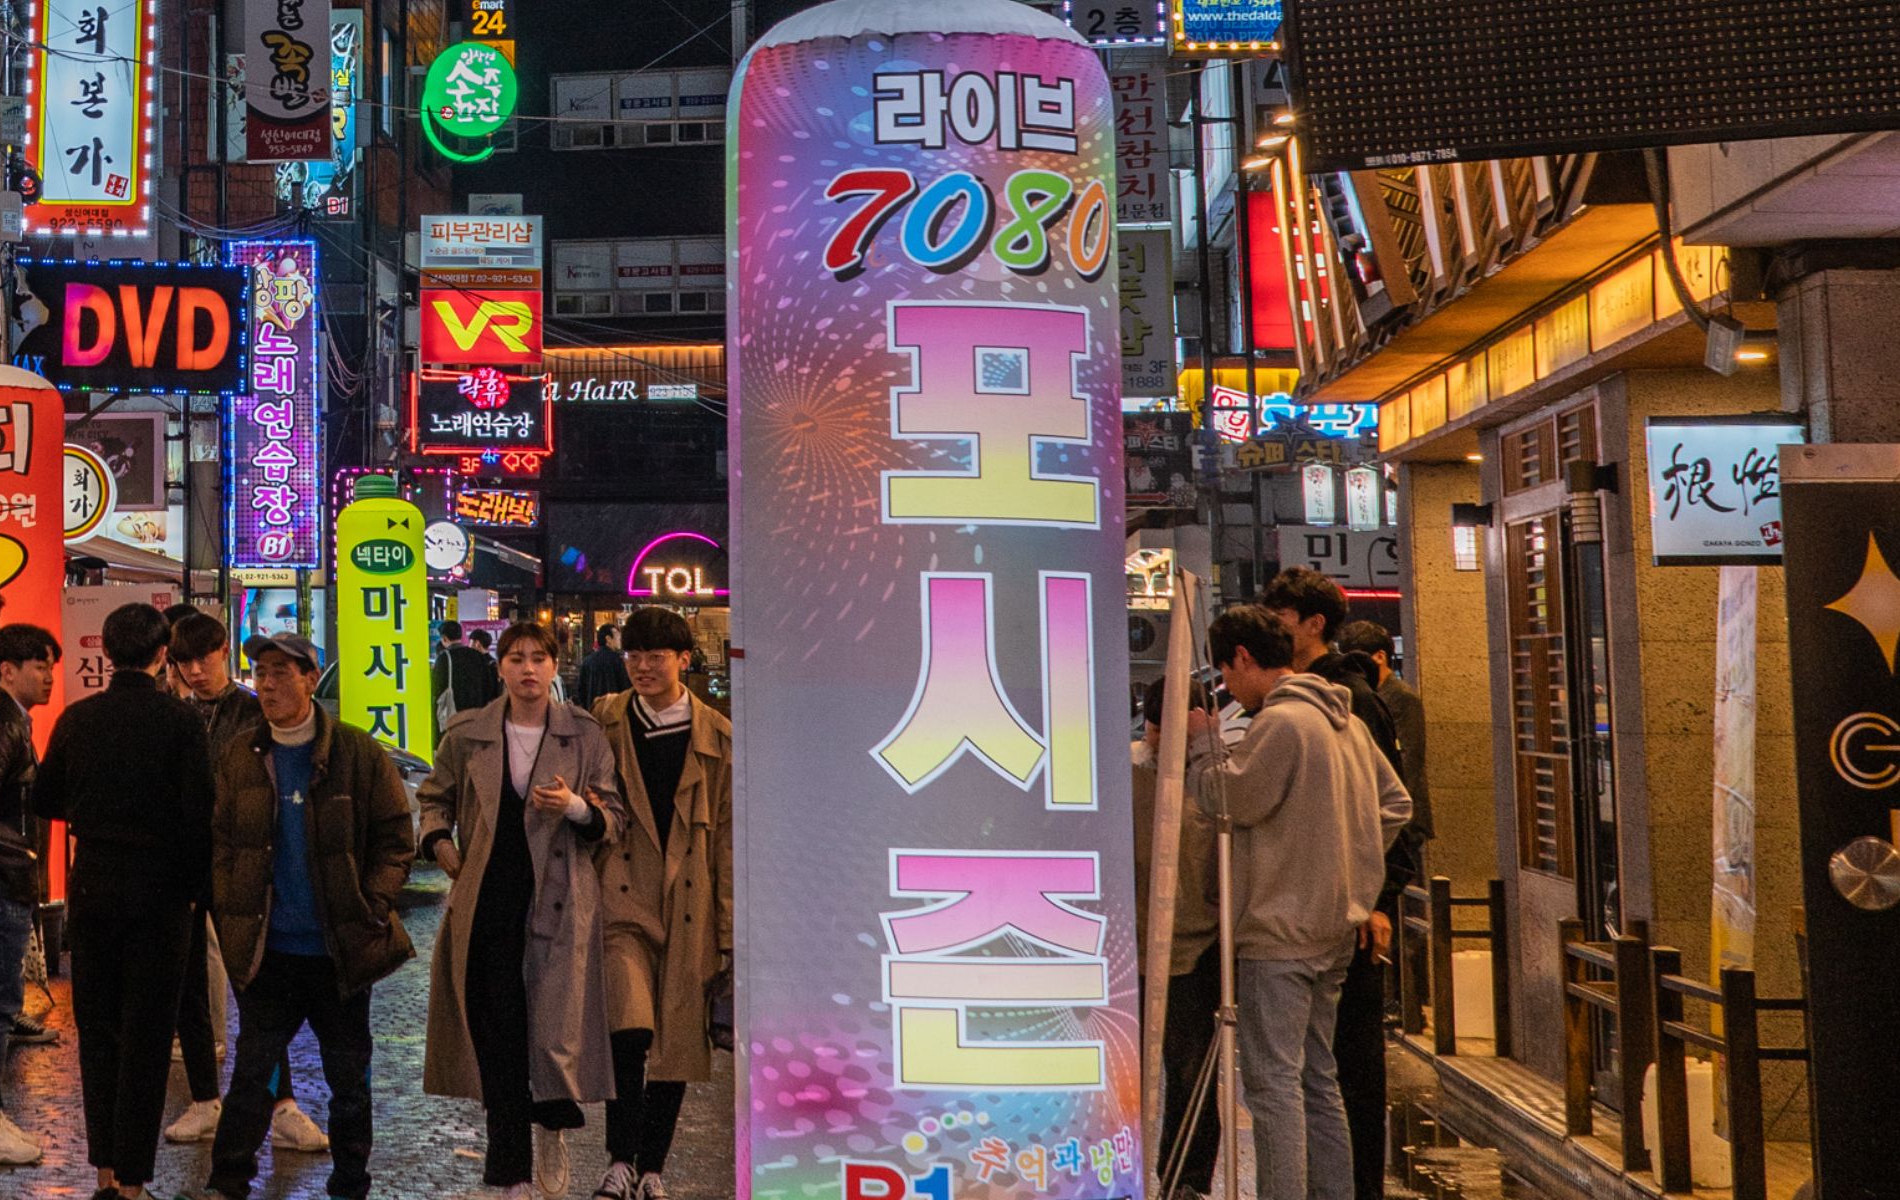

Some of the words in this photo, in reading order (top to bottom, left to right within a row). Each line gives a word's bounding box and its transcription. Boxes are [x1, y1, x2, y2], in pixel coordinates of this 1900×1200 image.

[471, 10, 508, 35] 24
[1087, 7, 1142, 37] 2층
[871, 69, 1079, 156] 라이브
[430, 222, 533, 245] 피부관리샵
[823, 168, 1111, 283] 7080
[62, 282, 231, 371] DVD
[431, 301, 534, 353] VR
[1148, 358, 1169, 375] 3F
[251, 322, 299, 526] 노래연습장
[430, 412, 534, 439] 노래연습장
[461, 455, 480, 473] 3F
[261, 536, 290, 558] B1
[356, 545, 407, 568] 넥타이
[360, 583, 410, 751] 마사지
[868, 300, 1109, 1091] 포시즌
